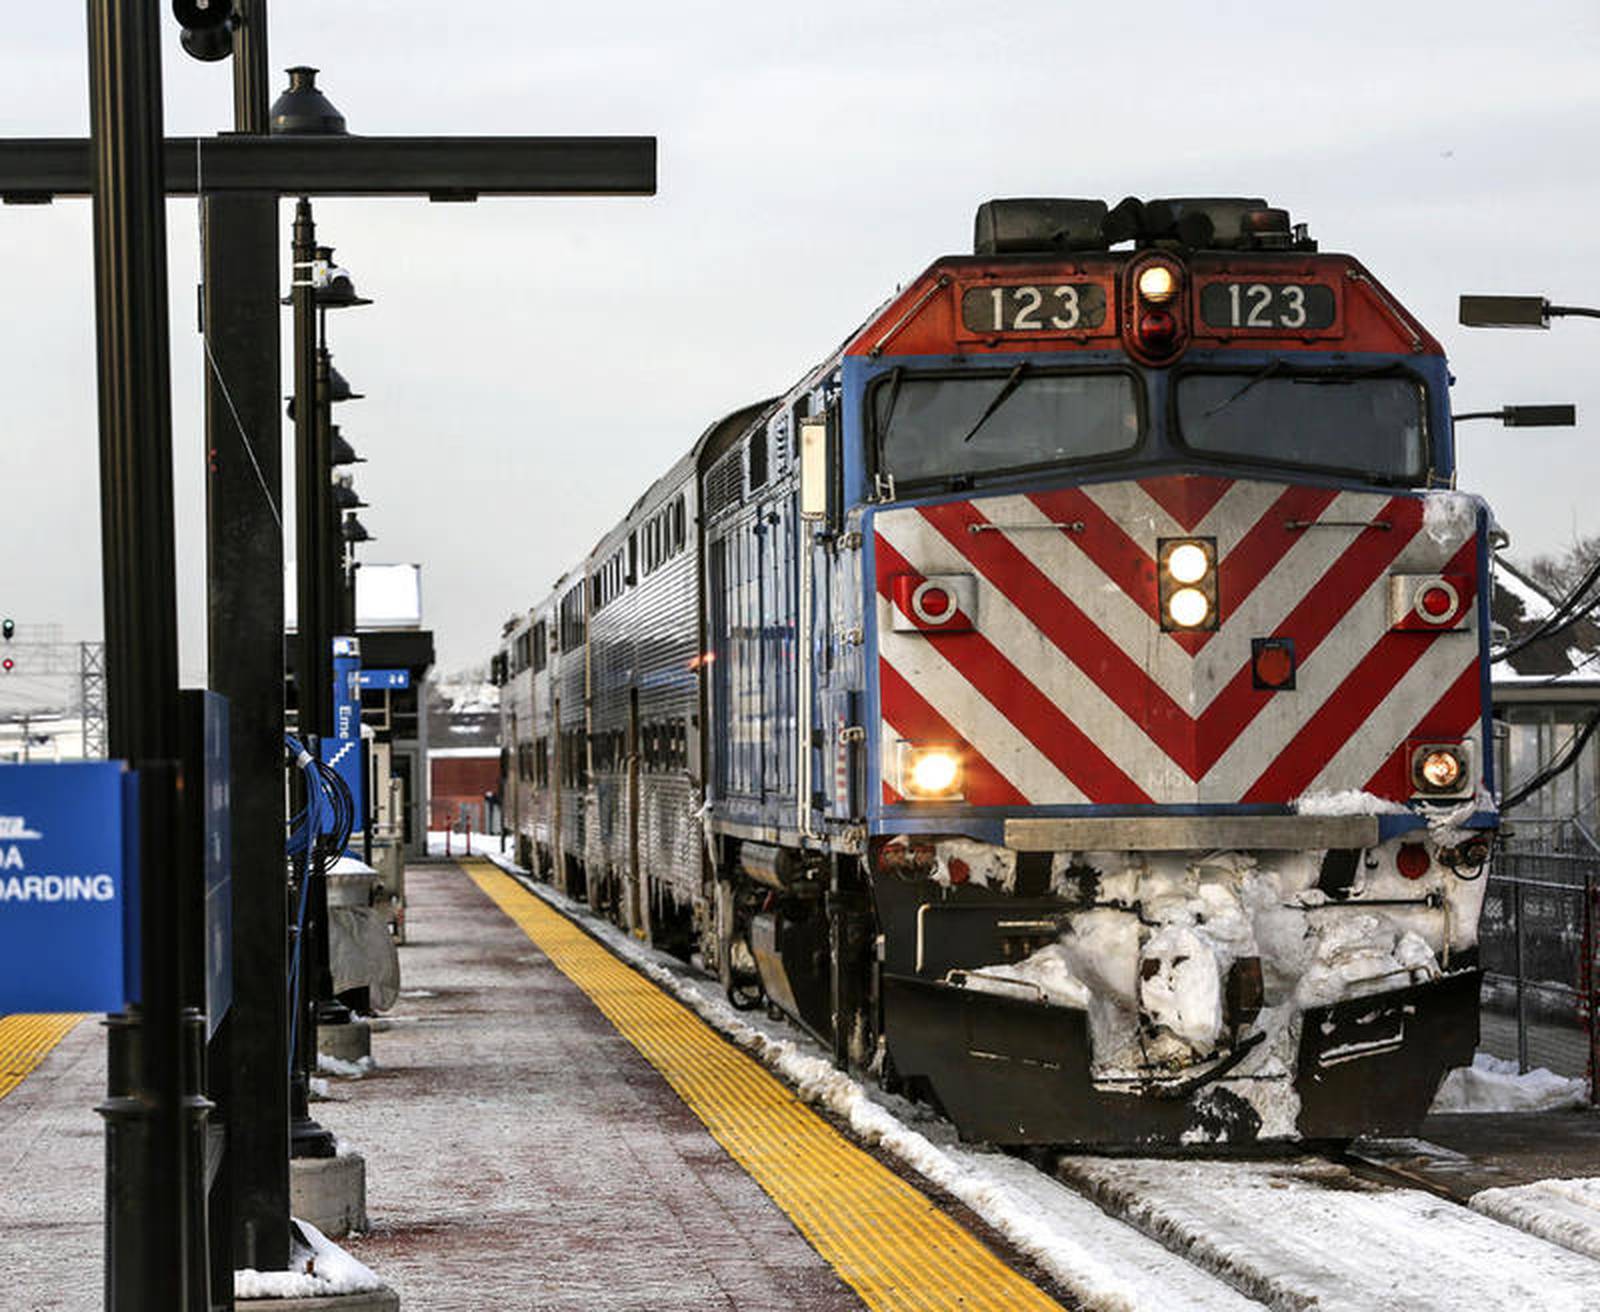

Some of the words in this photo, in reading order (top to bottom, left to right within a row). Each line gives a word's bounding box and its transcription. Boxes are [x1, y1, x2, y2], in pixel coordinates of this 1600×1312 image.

[990, 285, 1081, 331] 123
[1227, 283, 1307, 328] 123
[0, 845, 24, 870] A
[0, 875, 115, 901] ARDING
